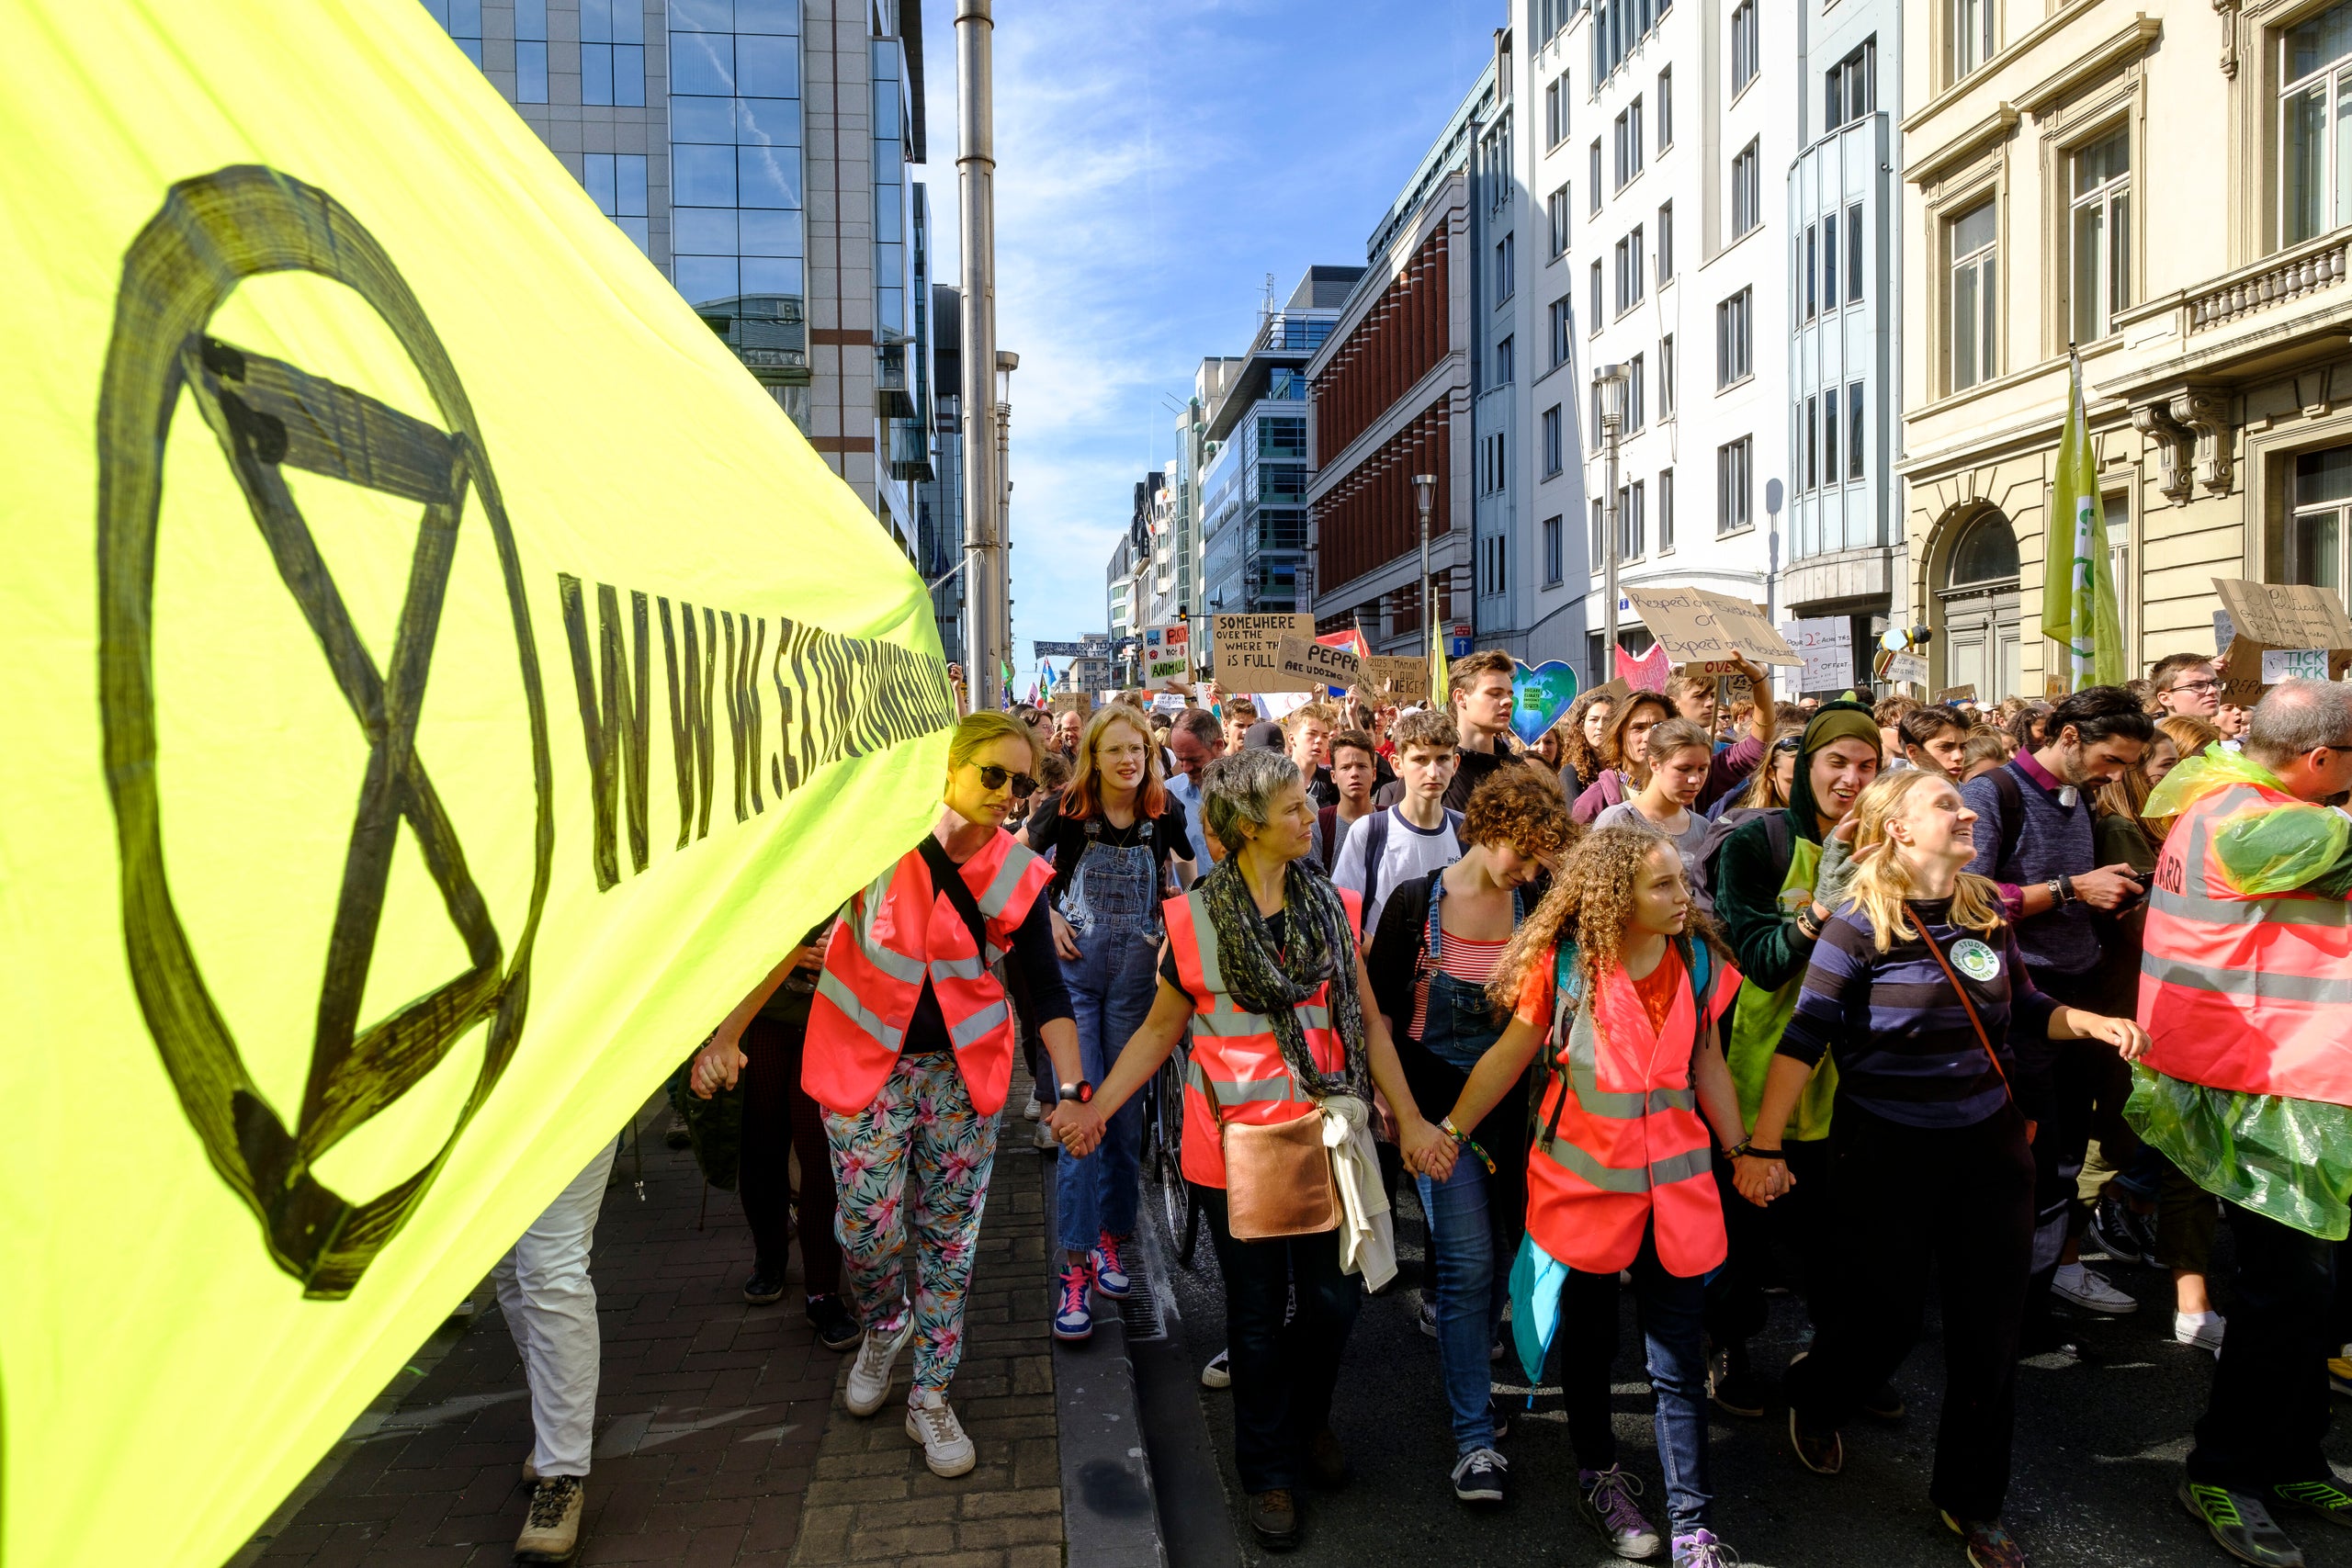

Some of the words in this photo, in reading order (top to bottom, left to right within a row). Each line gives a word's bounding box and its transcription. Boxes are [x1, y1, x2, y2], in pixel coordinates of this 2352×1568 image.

[1631, 592, 1690, 613] Respect
[1219, 616, 1295, 629] SOMEWHERE
[1147, 632, 1160, 646] eat
[1216, 630, 1240, 639] OVER
[1242, 630, 1262, 639] THE
[1225, 641, 1261, 651] WHERE
[1266, 641, 1279, 650] TH
[1659, 633, 1721, 658] Expect
[1244, 654, 1275, 668] FULL
[1284, 660, 1304, 671] ARE
[1307, 645, 1359, 673] PEPPA
[2283, 650, 2326, 667] TICK
[1152, 660, 1186, 677] ANIMALS
[2283, 666, 2327, 680] TOCK
[1390, 680, 1425, 694] NEIGE?
[1958, 940, 1996, 964] STUDENTS
